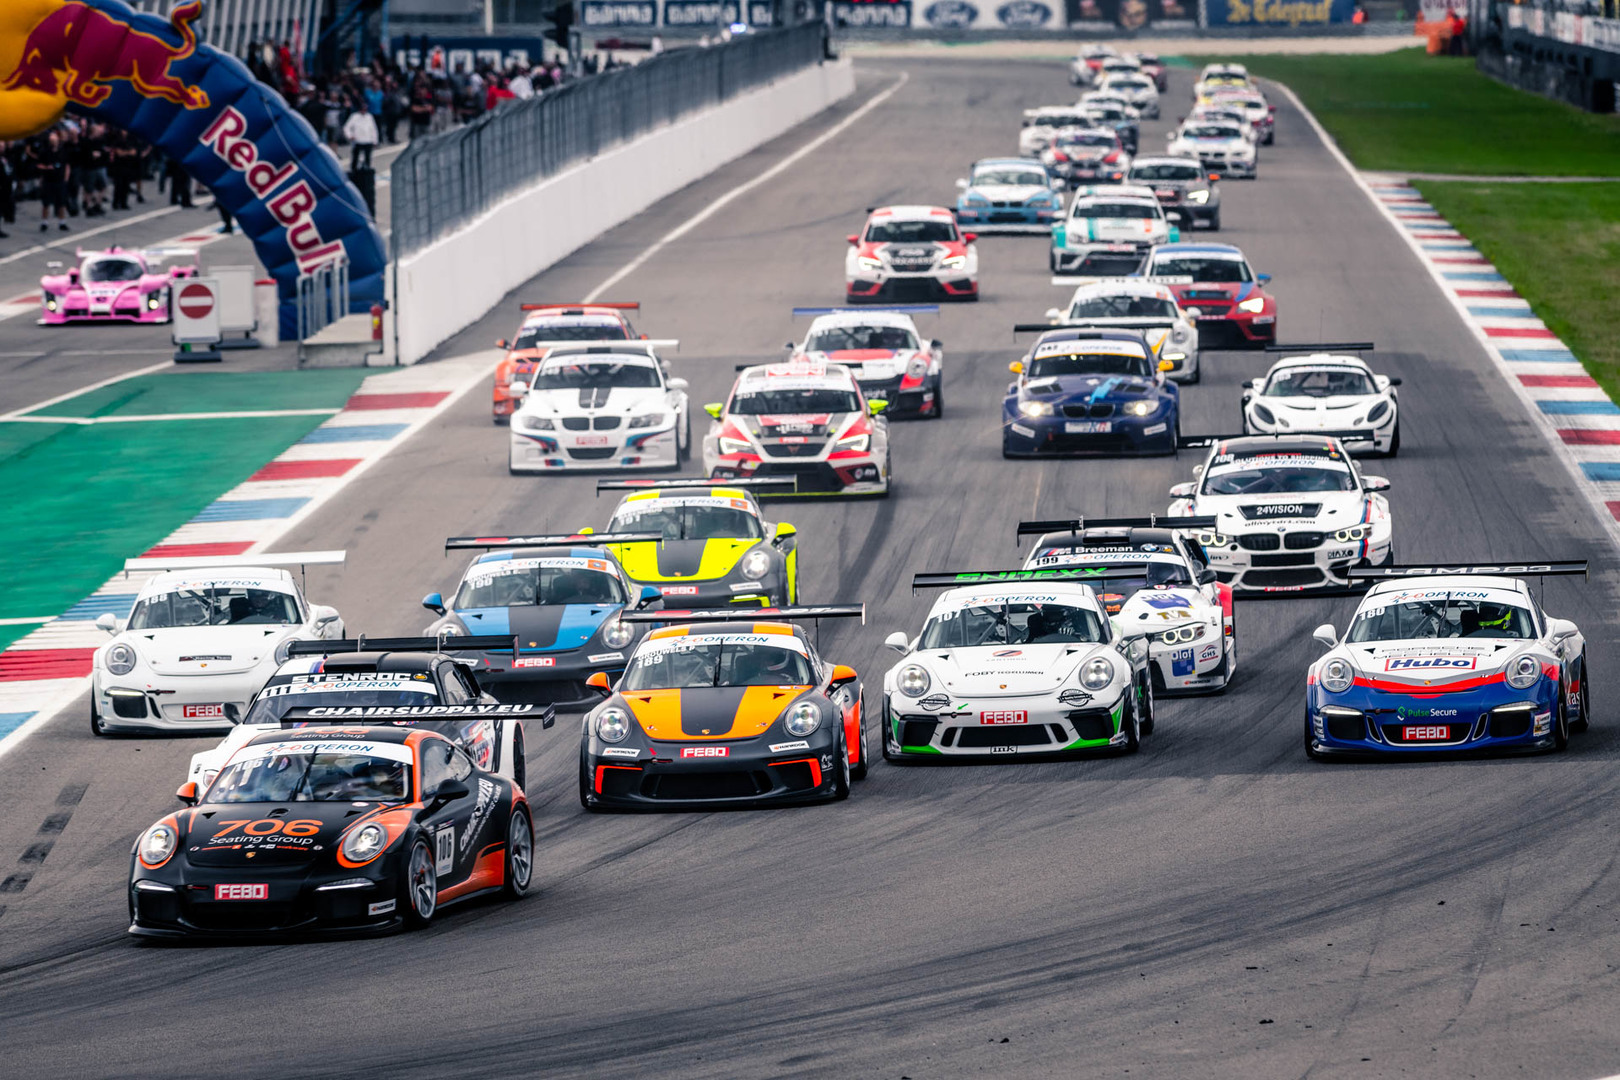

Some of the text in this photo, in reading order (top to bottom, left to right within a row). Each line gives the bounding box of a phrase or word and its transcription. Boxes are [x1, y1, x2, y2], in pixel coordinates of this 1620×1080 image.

[199, 105, 299, 200] Red
[1214, 453, 1235, 465] 108
[1256, 504, 1303, 515] 24VISION
[1075, 545, 1134, 553] Breeman
[1034, 556, 1059, 566] 199
[1358, 607, 1386, 621] 180
[1171, 648, 1194, 660] olof
[636, 655, 664, 669] 189
[1390, 658, 1471, 669] Hubo
[291, 672, 412, 684] STENROC
[264, 685, 292, 698] 111
[307, 704, 534, 717] CHAIRSUPPLY.EU
[984, 711, 1025, 724] FEBO
[1405, 726, 1448, 739] FEBO
[682, 747, 727, 758] FEBO
[212, 818, 324, 839] 706
[208, 834, 314, 846] Seating Group
[438, 832, 452, 862] 106
[218, 884, 264, 899] FEBO
